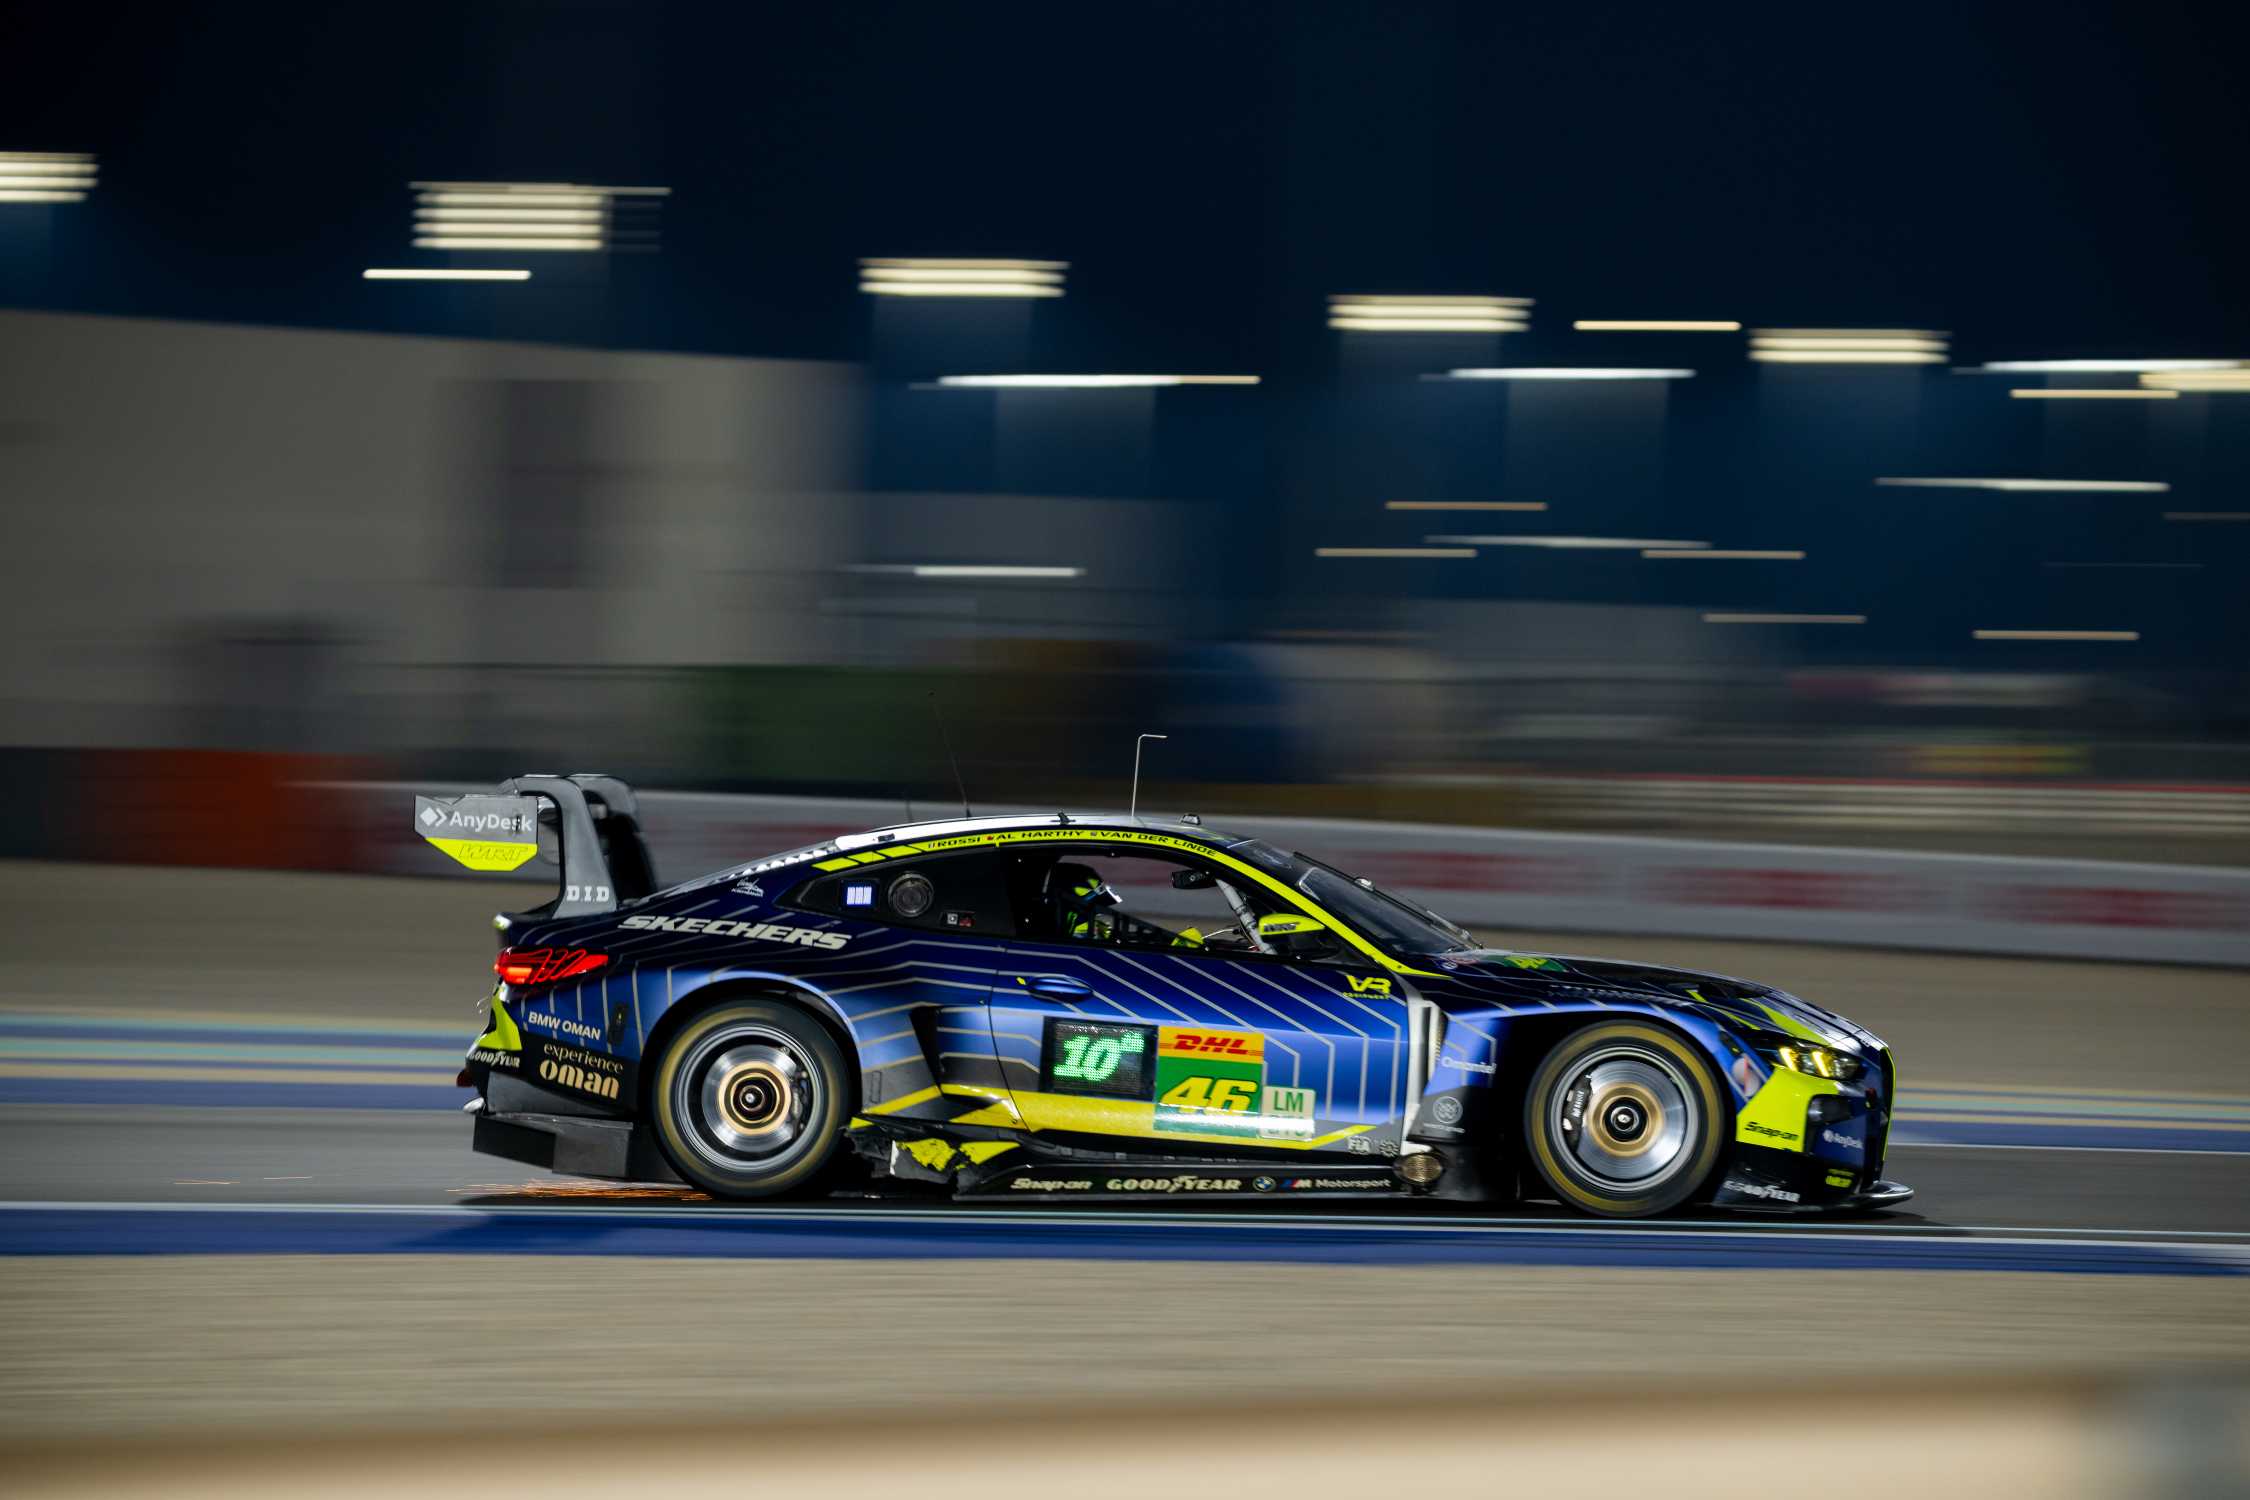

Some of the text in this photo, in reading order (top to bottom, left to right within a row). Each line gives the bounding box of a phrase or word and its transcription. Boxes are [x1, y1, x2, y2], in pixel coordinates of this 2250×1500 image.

[450, 811, 533, 833] AnyDesk
[938, 830, 1217, 857] ROSSI AL HARTHY VAN DER LINDE
[617, 915, 852, 949] SKECHERS
[1346, 975, 1392, 994] VR
[528, 1012, 600, 1040] BMW OMAN
[1174, 1034, 1248, 1055] DHL
[543, 1042, 623, 1074] experience
[539, 1058, 620, 1099] oman
[1161, 1076, 1258, 1116] 46
[1273, 1090, 1304, 1112] LM
[1744, 1121, 1799, 1141] Snap-on
[1010, 1177, 1093, 1191] Snap-on
[1106, 1175, 1242, 1193] GOODYEAR
[1315, 1179, 1391, 1189] Motorsport
